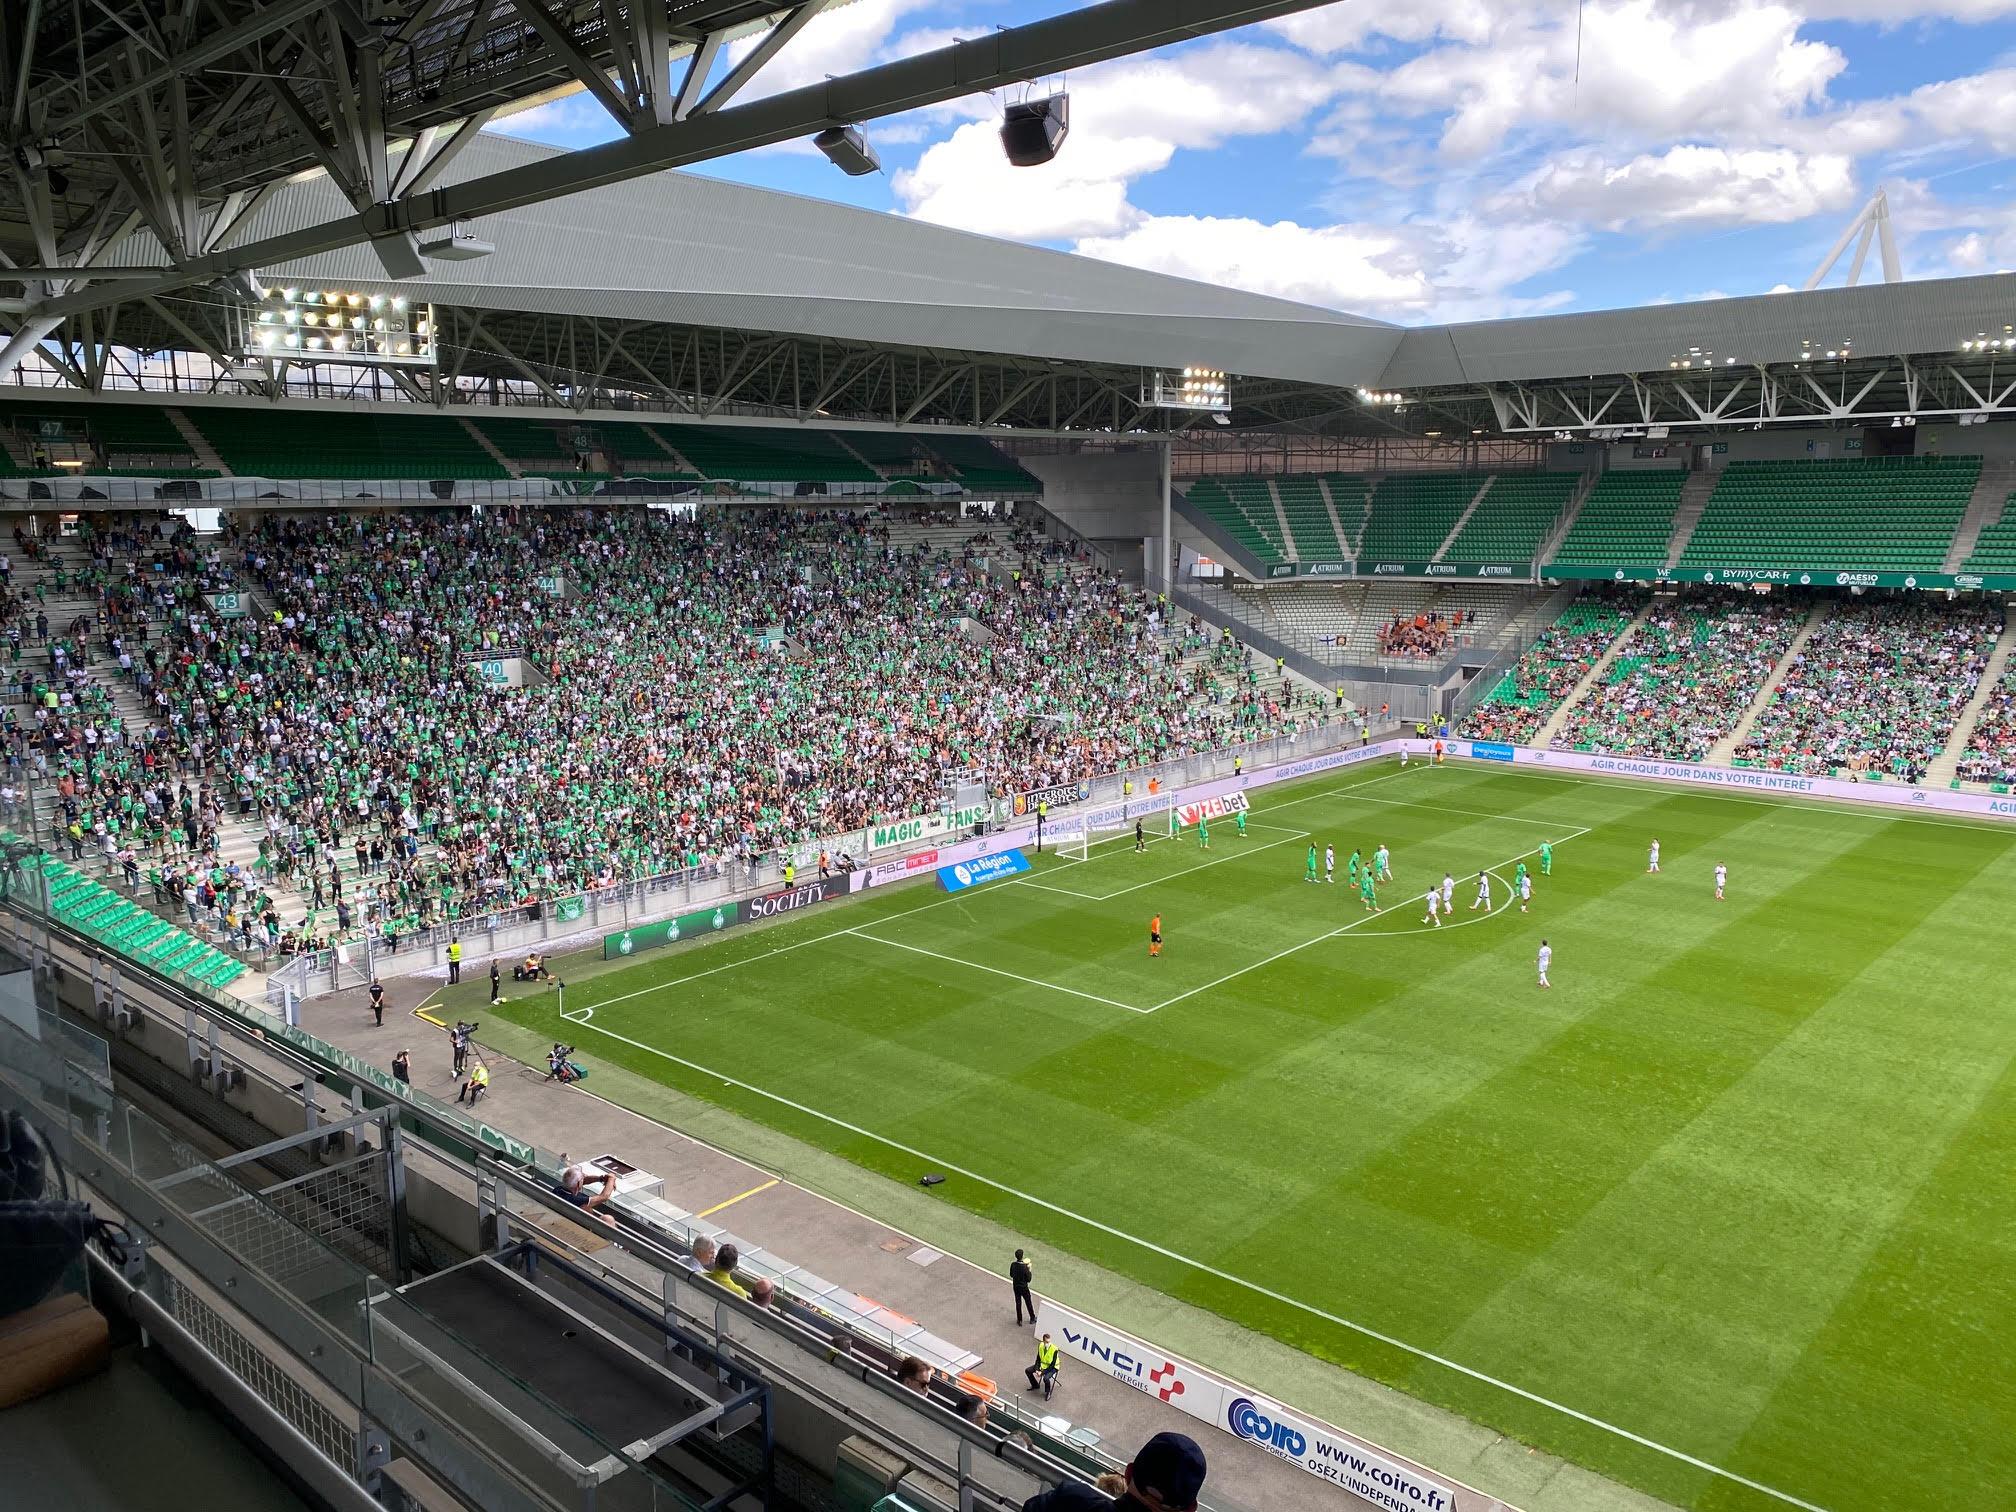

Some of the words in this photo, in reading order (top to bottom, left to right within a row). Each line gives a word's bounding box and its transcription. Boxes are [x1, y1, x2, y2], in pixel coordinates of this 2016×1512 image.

[41, 422, 61, 436] 47
[574, 436, 588, 447] 48
[1714, 444, 1727, 452] 35
[1847, 440, 1861, 448] 36
[1317, 565, 1343, 573] ATRIUM
[1380, 565, 1405, 573] ATRIUM
[1430, 565, 1457, 574] ATRIUM
[1485, 566, 1512, 575] ATRIUM
[539, 579, 555, 590] 44
[217, 594, 238, 609] 43
[484, 662, 502, 675] 40
[1275, 766, 1290, 778] AGIR
[1290, 761, 1314, 775] CHAQUE
[1314, 758, 1329, 769] JOUR
[1329, 754, 1344, 765] DANS
[1344, 750, 1361, 762] VOTRE
[1590, 759, 1615, 770] AGIR
[1617, 762, 1660, 776] CHAQUE
[1662, 765, 1690, 778] JOUR
[1693, 769, 1723, 782] DANS
[1726, 773, 1762, 786] VOTRE
[874, 821, 922, 847] MAGIC
[946, 807, 983, 830] FANS
[1049, 818, 1081, 835] CHAQUE
[1105, 808, 1124, 821] DANS
[876, 860, 905, 876] ABC
[966, 862, 980, 873] La
[979, 854, 1012, 871] Région
[749, 885, 827, 919] SOCIETY
[1062, 1327, 1143, 1377] VINCI
[1113, 1369, 1149, 1392] ENERGIES
[1266, 1443, 1289, 1460] FOREZ
[1308, 1459, 1338, 1479] OSEZ
[1316, 1440, 1445, 1512] www.coiro.fr
